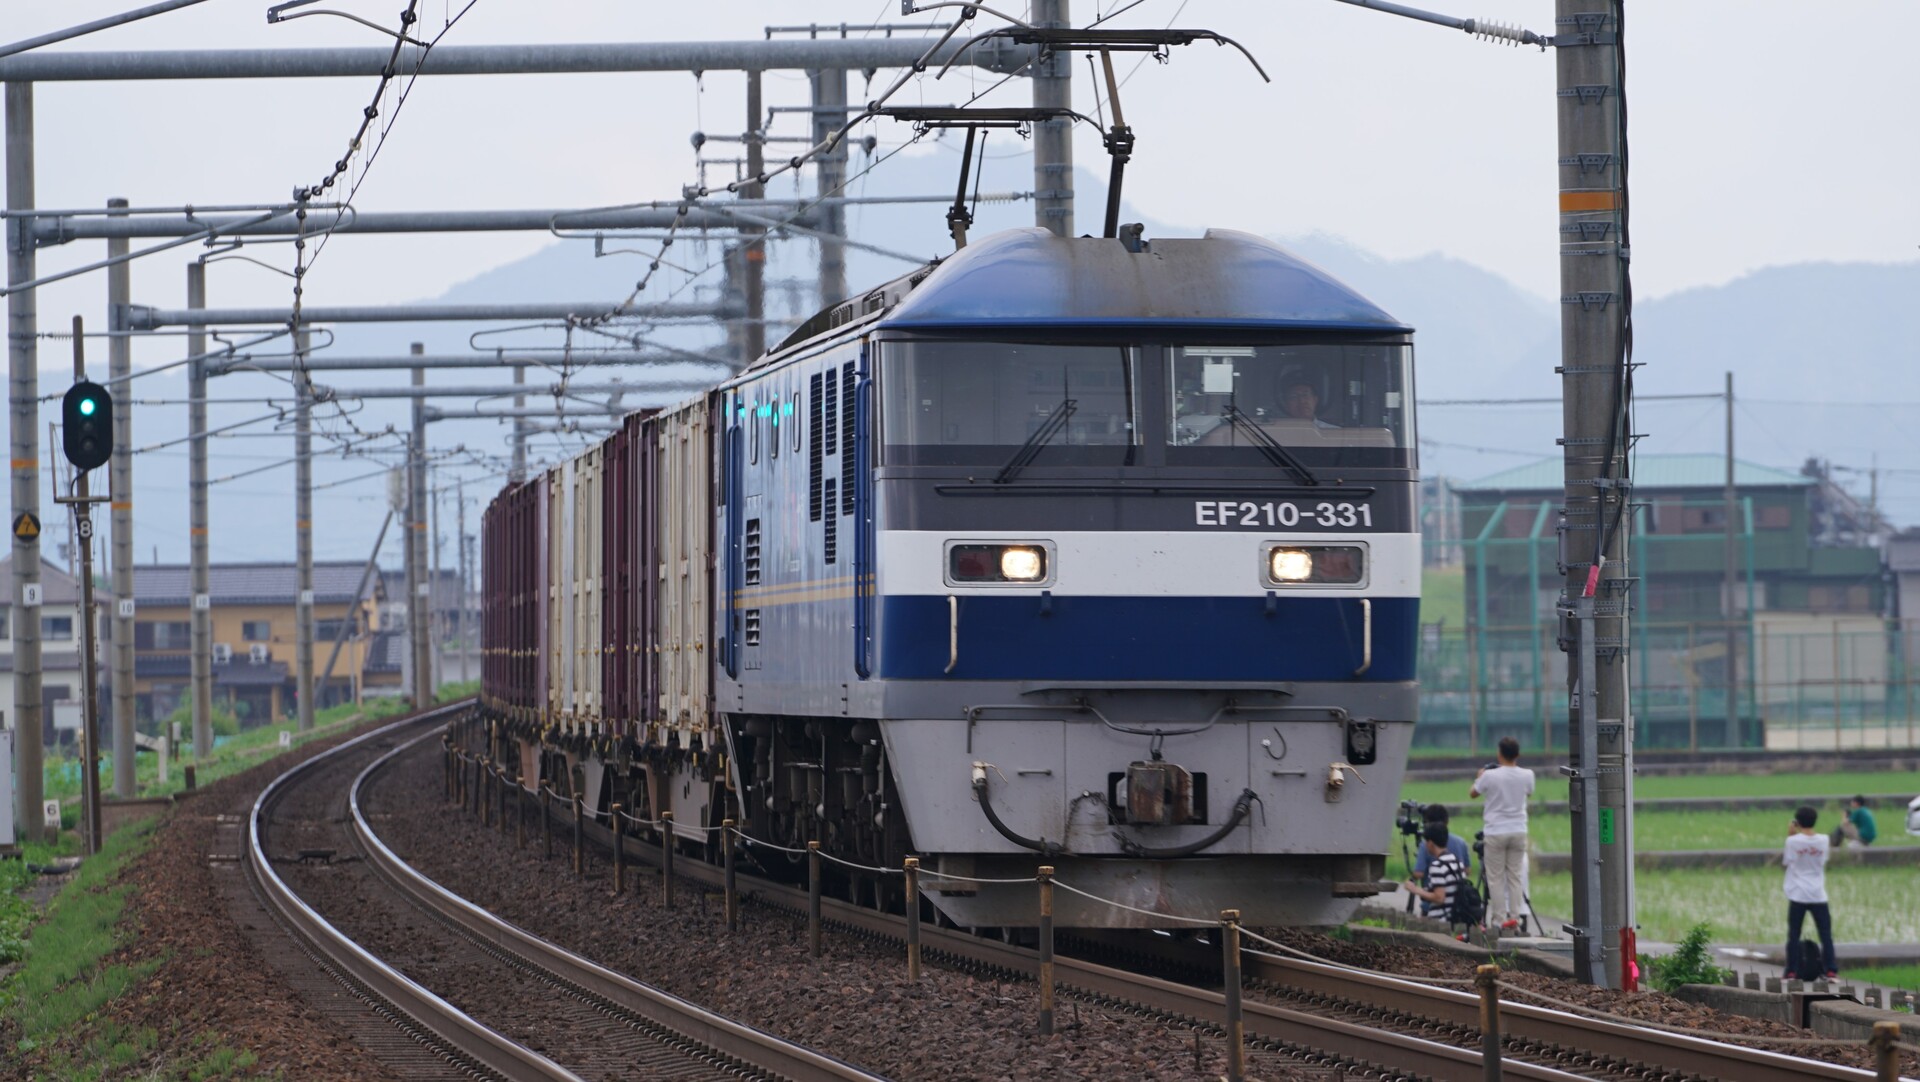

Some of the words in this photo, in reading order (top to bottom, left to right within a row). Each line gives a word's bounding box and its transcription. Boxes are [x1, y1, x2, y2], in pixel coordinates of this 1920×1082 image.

[1195, 501, 1372, 527] EF210-331
[80, 520, 91, 537] 8
[29, 588, 35, 601] 9
[123, 603, 132, 611] 10
[47, 804, 56, 816] 6
